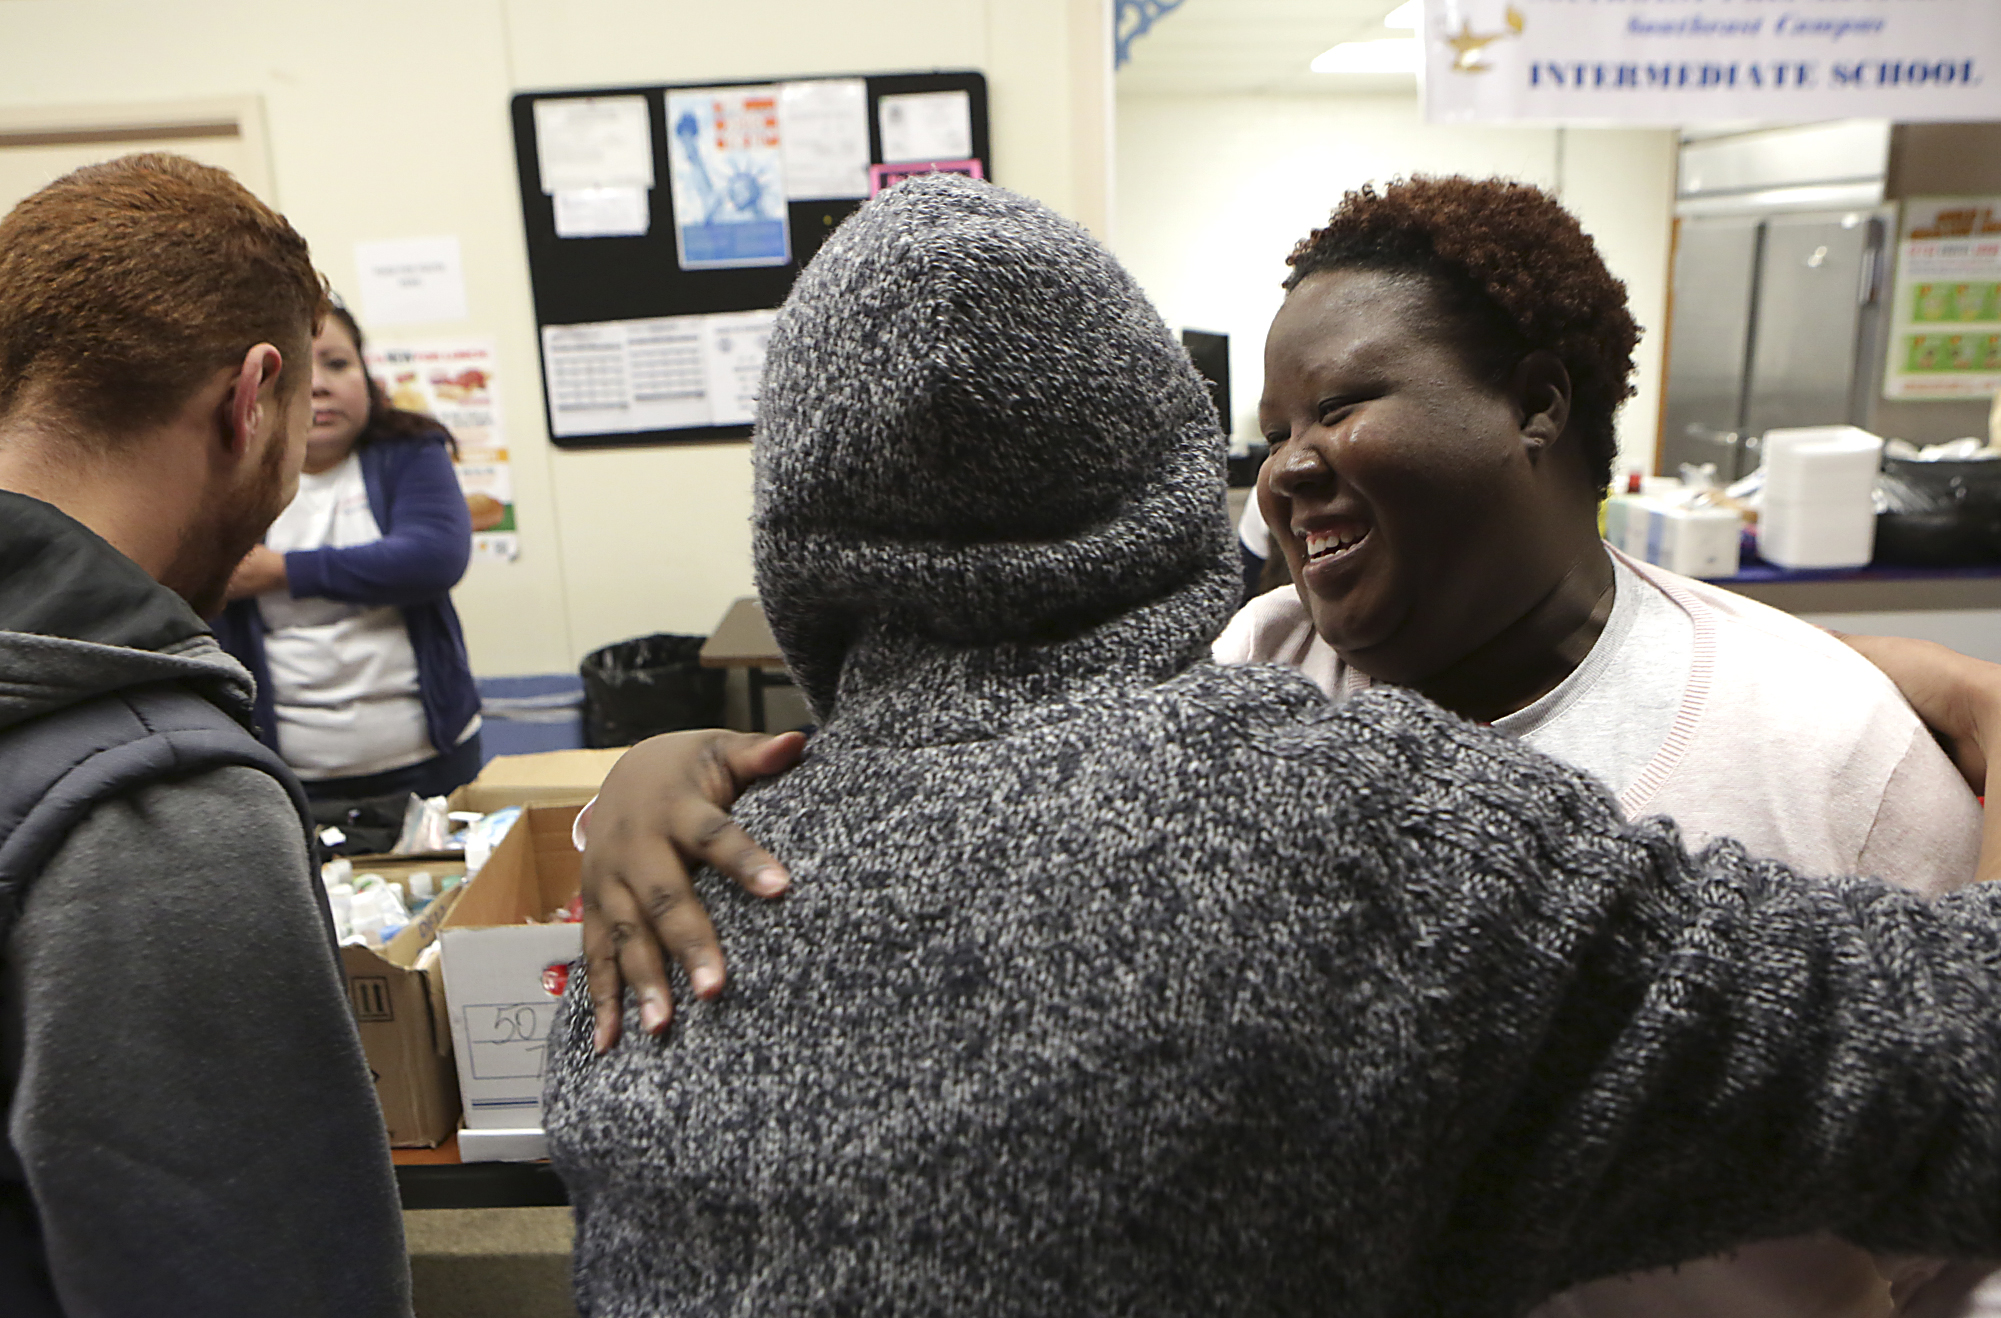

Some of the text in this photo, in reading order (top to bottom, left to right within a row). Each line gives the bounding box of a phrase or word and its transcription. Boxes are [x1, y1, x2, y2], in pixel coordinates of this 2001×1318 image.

[1773, 12, 1885, 41] Campus
[1531, 61, 1982, 89] INTERMEDIATE SCHOOL
[493, 1004, 536, 1045] 50
